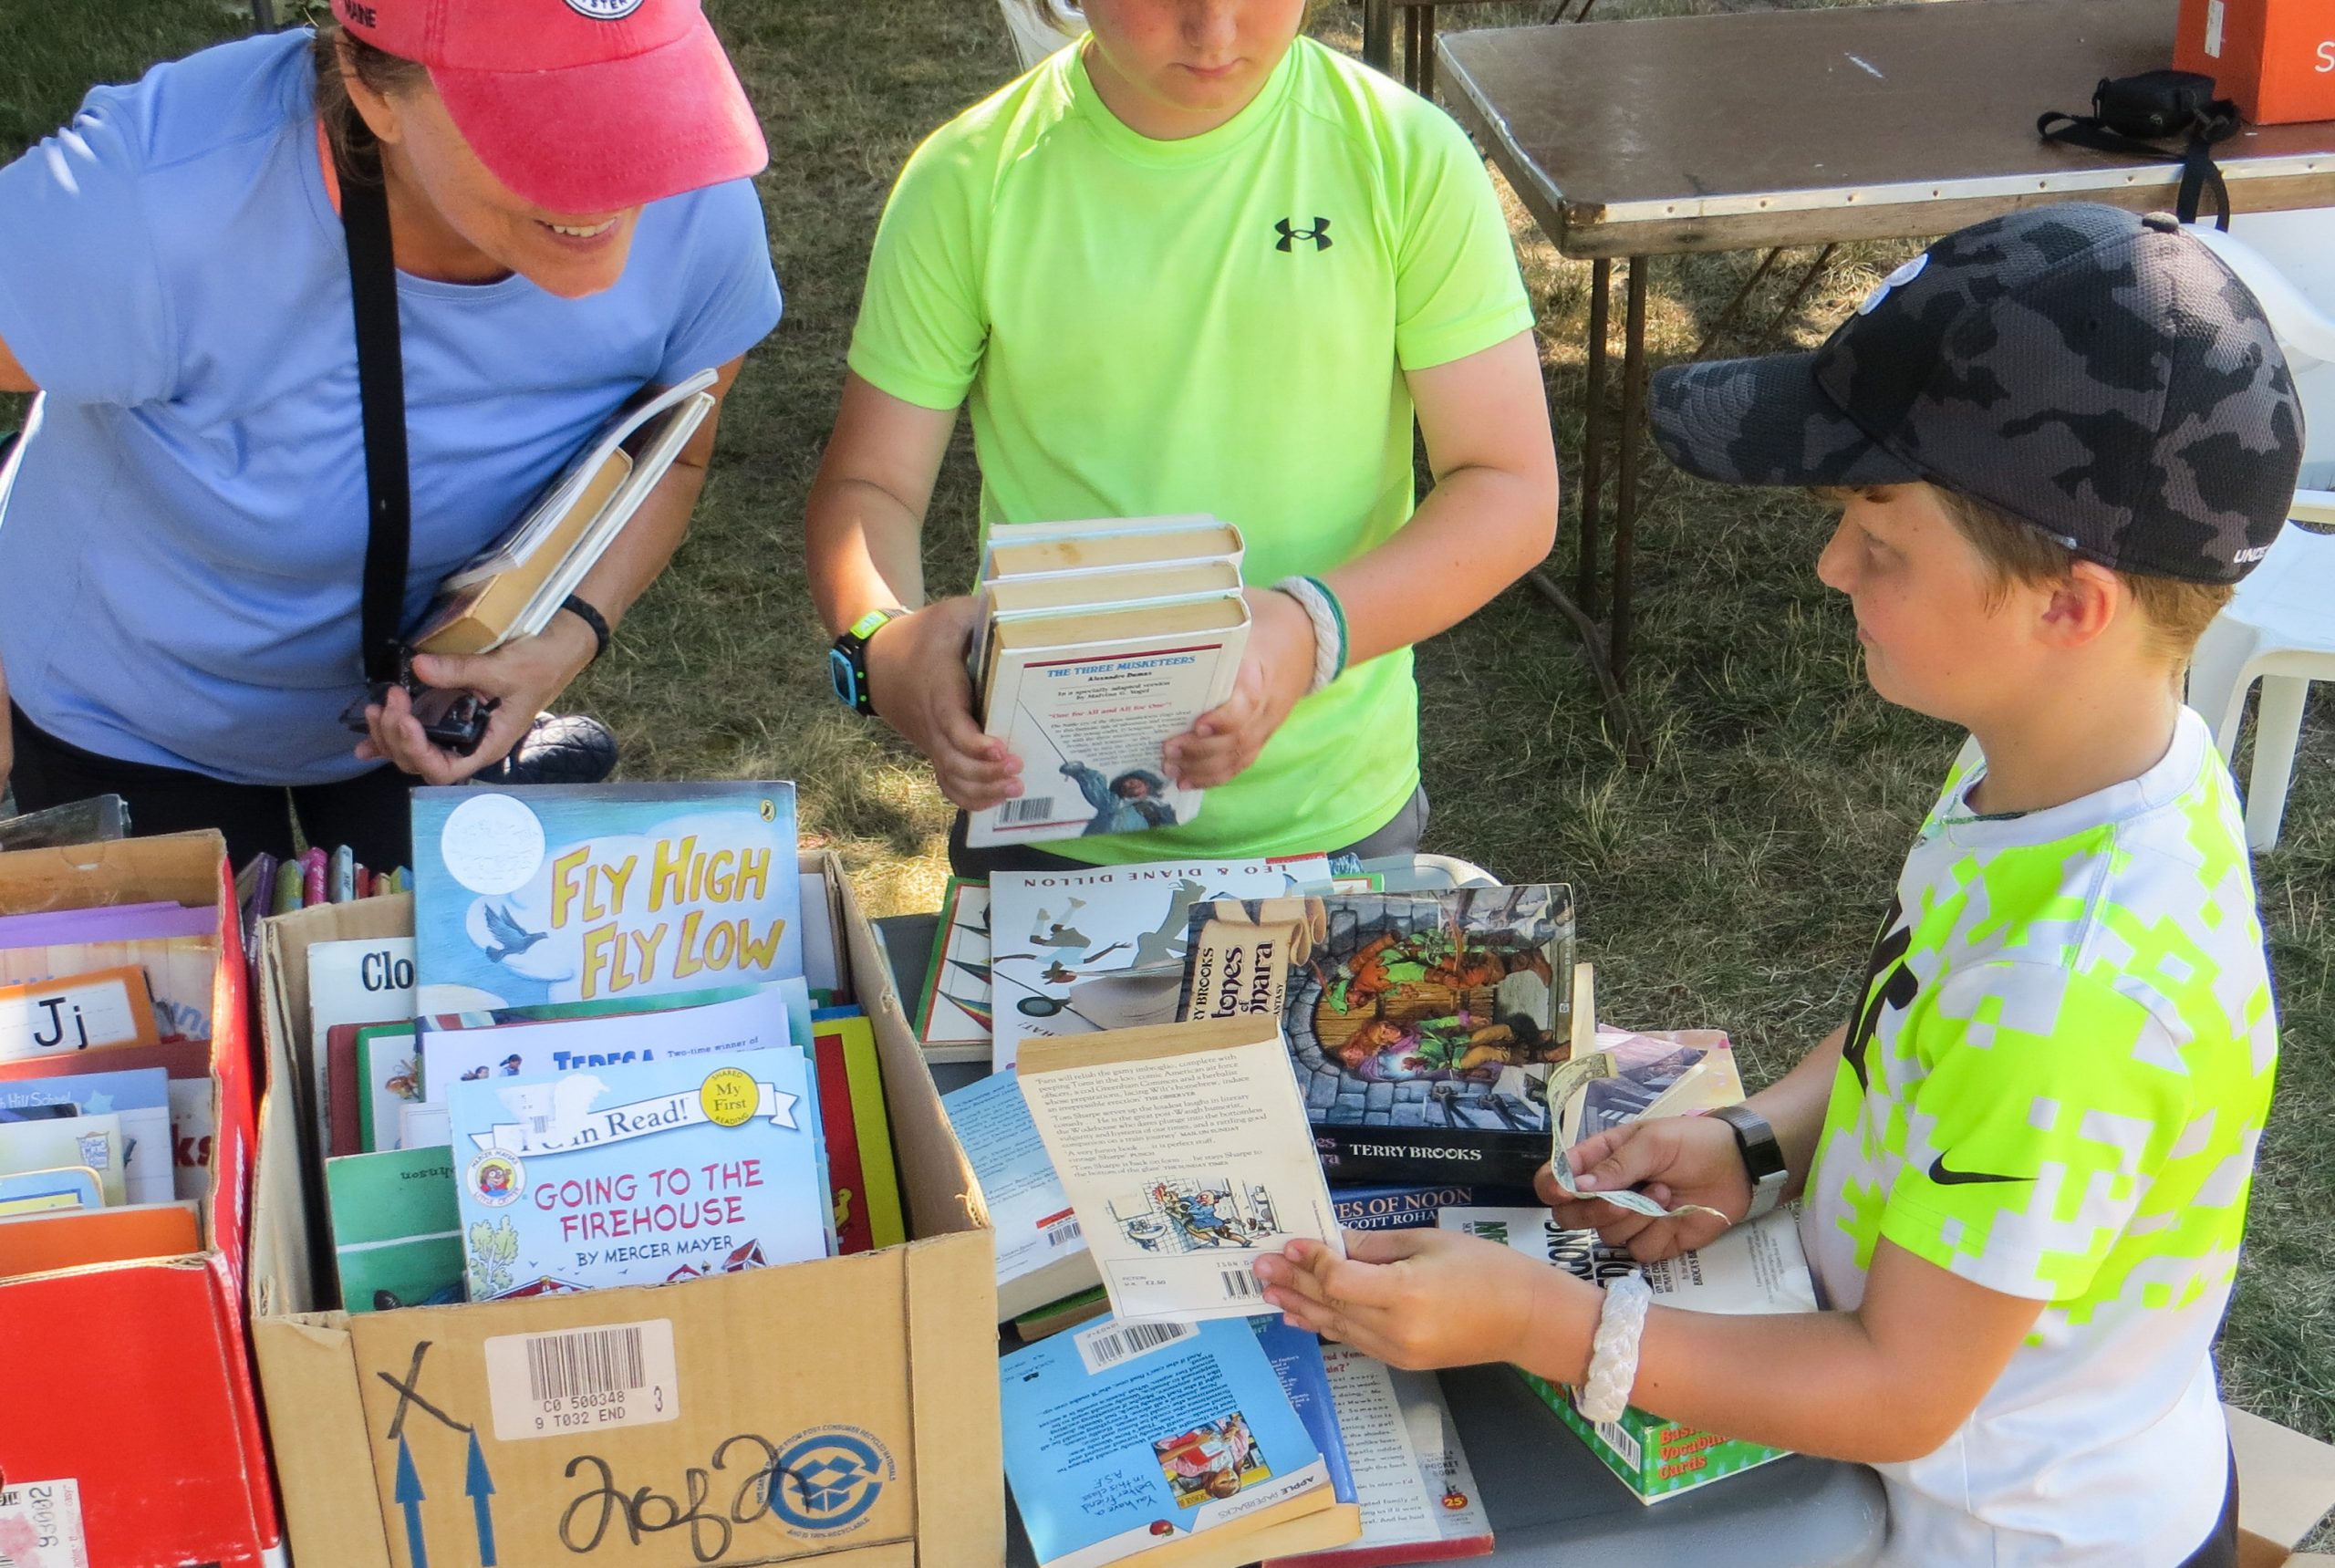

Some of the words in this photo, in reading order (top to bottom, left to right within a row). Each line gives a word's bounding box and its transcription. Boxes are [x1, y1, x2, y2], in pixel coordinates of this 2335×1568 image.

[1046, 669, 1072, 678] THE
[1074, 663, 1115, 676] THREE
[1118, 655, 1196, 670] MUSKETEERS
[1127, 670, 1153, 679] Dumas
[1128, 867, 1202, 881] DIANE
[1217, 867, 1229, 876] &
[1244, 864, 1287, 875] LEO
[551, 846, 638, 929] FLY
[648, 835, 771, 913] HIGH
[1023, 874, 1113, 888] DILLON
[581, 920, 669, 1000] FLY
[673, 910, 786, 980] LOW
[1197, 946, 1214, 1005] BROOKS
[1210, 945, 1245, 1019] tones
[1272, 982, 1284, 1019] ANTASY
[34, 996, 88, 1050] Jj
[1016, 1022, 1054, 1037] HAT!
[668, 1046, 711, 1058] Two-time
[714, 1040, 747, 1051] winner
[750, 1036, 760, 1045] of
[711, 1069, 743, 1082] SHARED
[716, 1083, 742, 1100] My
[713, 1097, 747, 1112] First
[605, 1097, 688, 1137] Read!
[714, 1111, 751, 1126] READING
[1316, 1137, 1336, 1149] es
[1350, 1143, 1407, 1158] TERRY
[1407, 1147, 1482, 1161] BROOKS
[400, 1165, 454, 1181] hnson
[534, 1174, 638, 1210] GOING
[649, 1168, 691, 1197] TO
[701, 1159, 763, 1191] THE
[473, 1190, 494, 1205] LITTLE
[1369, 1197, 1399, 1215] OF
[1405, 1188, 1473, 1210] NOON
[560, 1196, 748, 1242] FIREHOUSE
[1394, 1210, 1437, 1225] ROHA
[576, 1251, 599, 1268] BY
[605, 1242, 672, 1263] MERCER
[677, 1236, 734, 1256] MAYER
[571, 1390, 626, 1409] 500348
[653, 1386, 663, 1413] 3
[535, 1417, 545, 1429] 9
[599, 1407, 626, 1422] END
[1659, 1428, 1695, 1446] Bas
[1425, 1460, 1459, 1469] POCKET
[1658, 1459, 1707, 1480] Cards
[1109, 1479, 1131, 1491] this
[1132, 1474, 1144, 1482] in
[1281, 1474, 1315, 1496] APPLE
[1081, 1493, 1116, 1514] friend
[1082, 1487, 1107, 1502] class
[1443, 1497, 1463, 1507] 25
[1107, 1499, 1136, 1517] have
